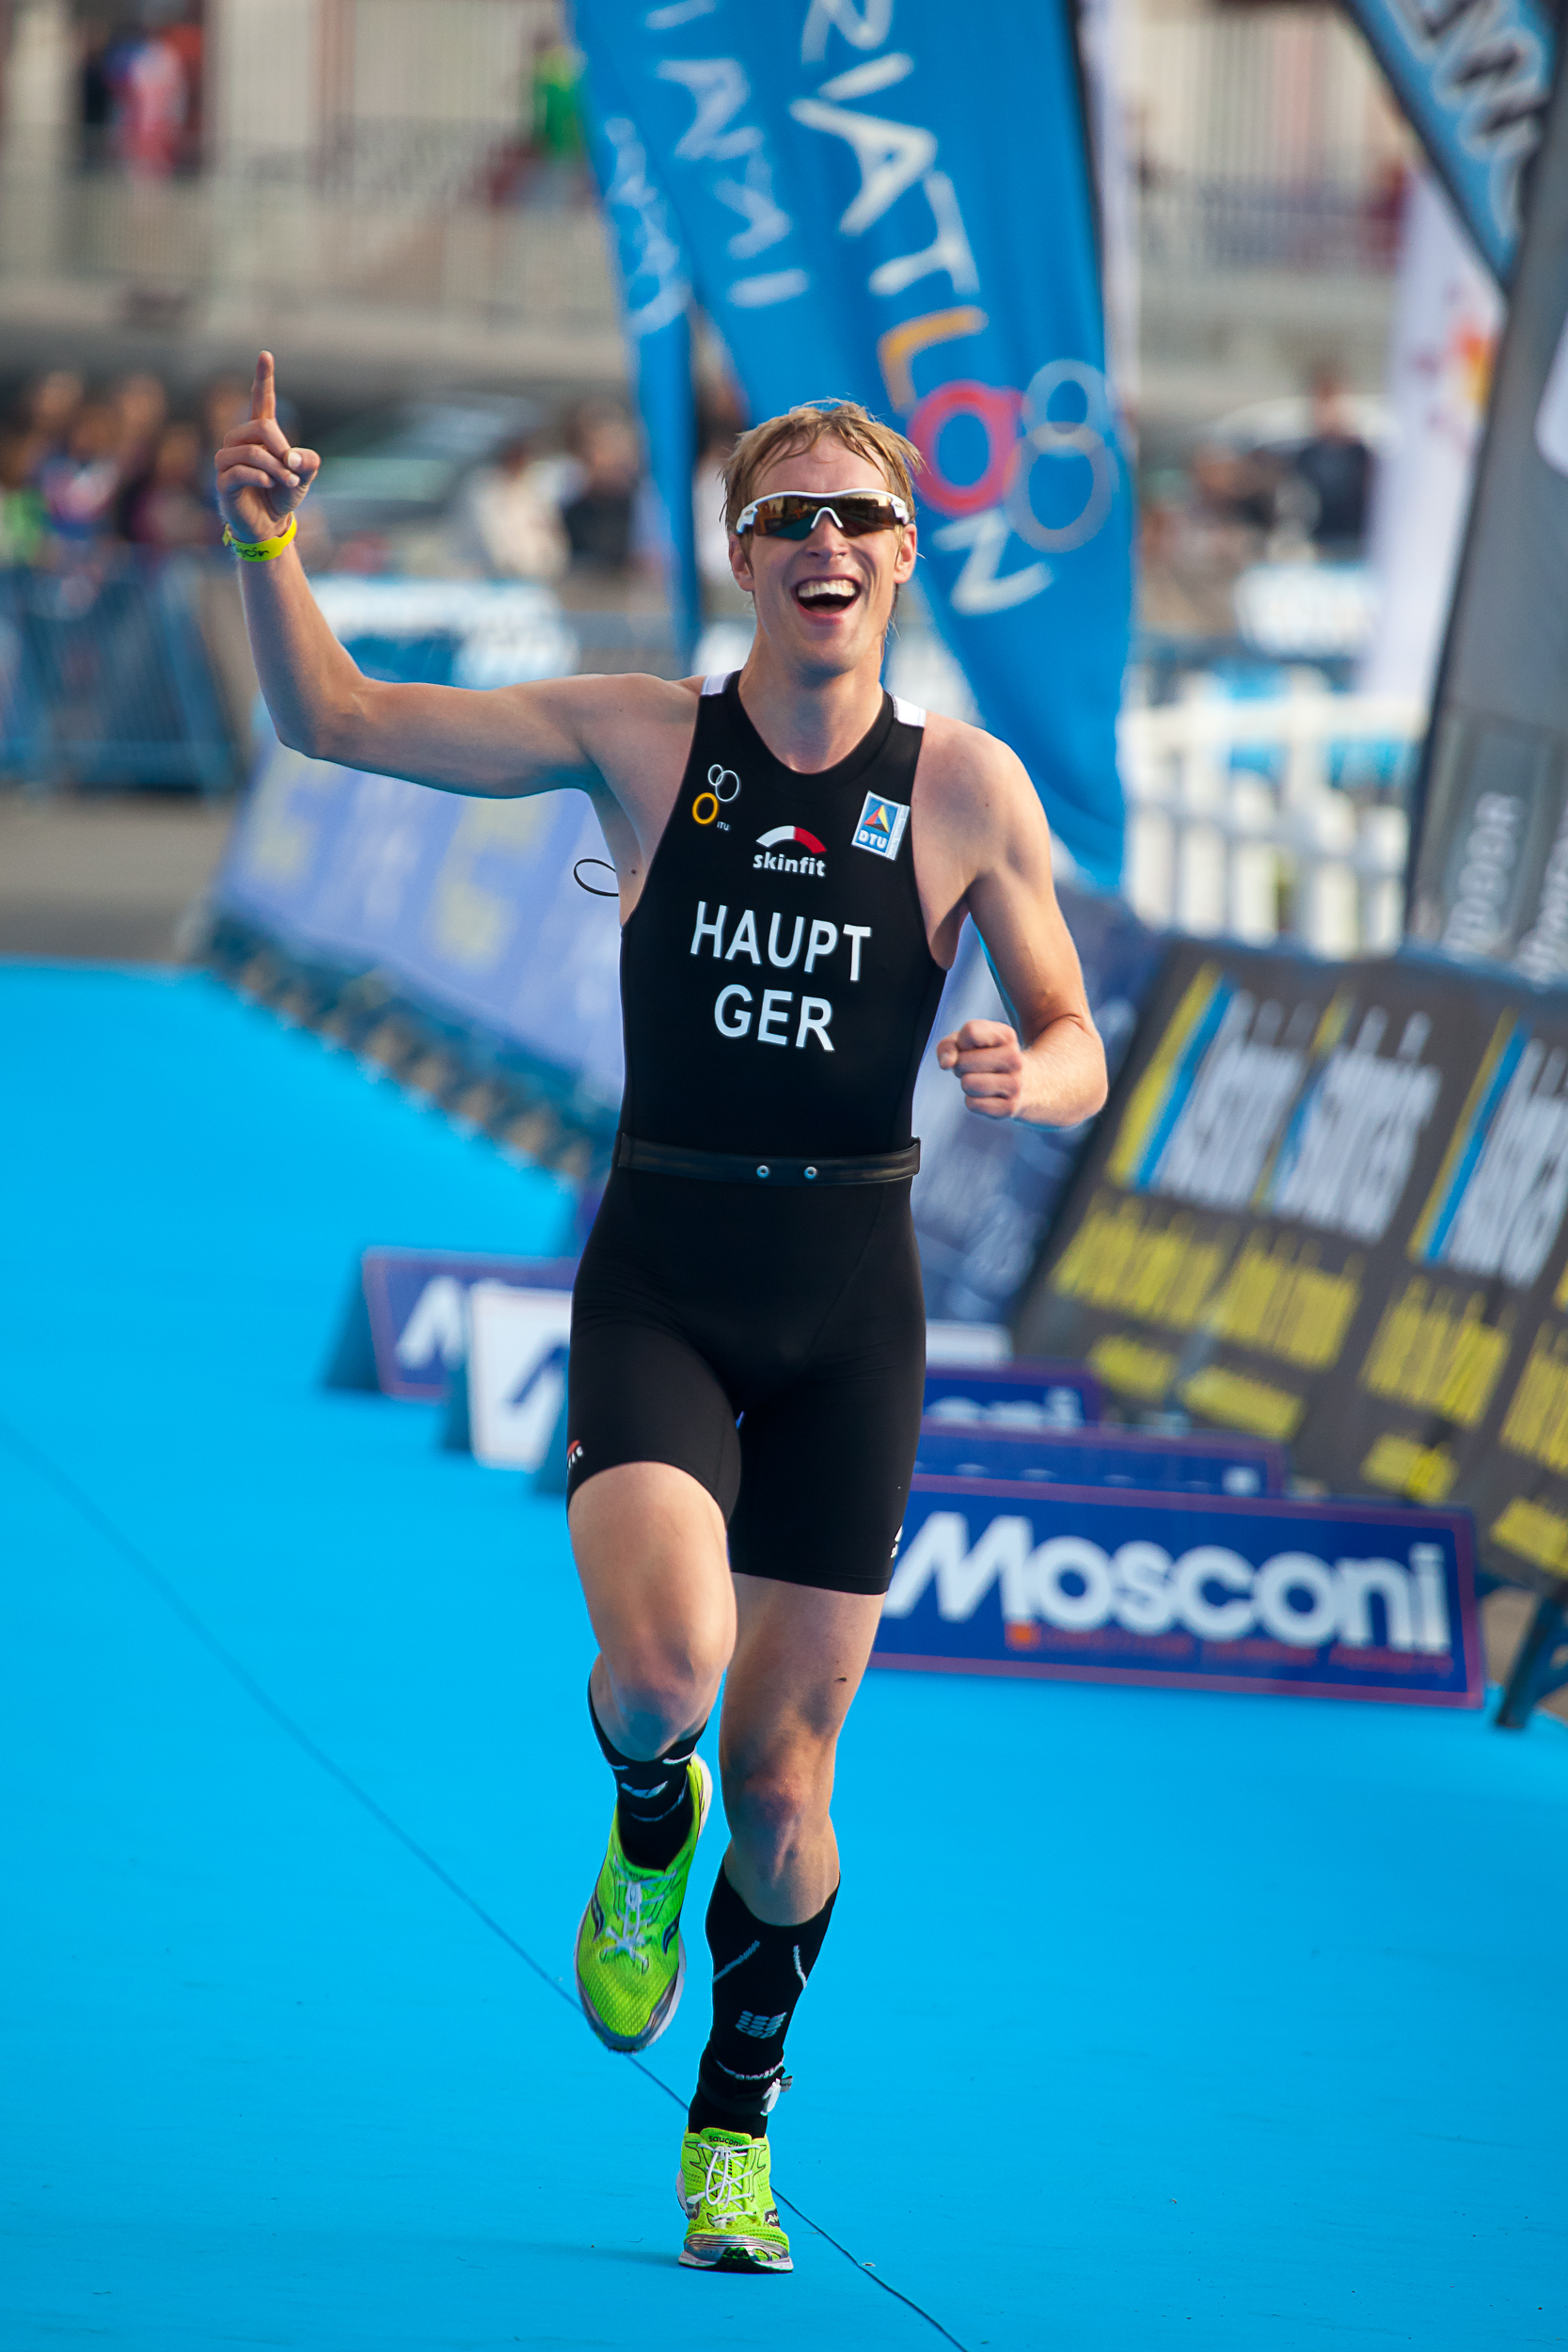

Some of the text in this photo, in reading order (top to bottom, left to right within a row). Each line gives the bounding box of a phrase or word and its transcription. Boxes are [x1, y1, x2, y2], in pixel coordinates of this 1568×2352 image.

[717, 820, 730, 832] ITU
[858, 829, 888, 850] DTU
[752, 851, 826, 877] skinfit
[689, 900, 872, 982] HAUPT
[714, 984, 835, 1052] GER
[881, 1511, 1450, 1655] Mosconi
